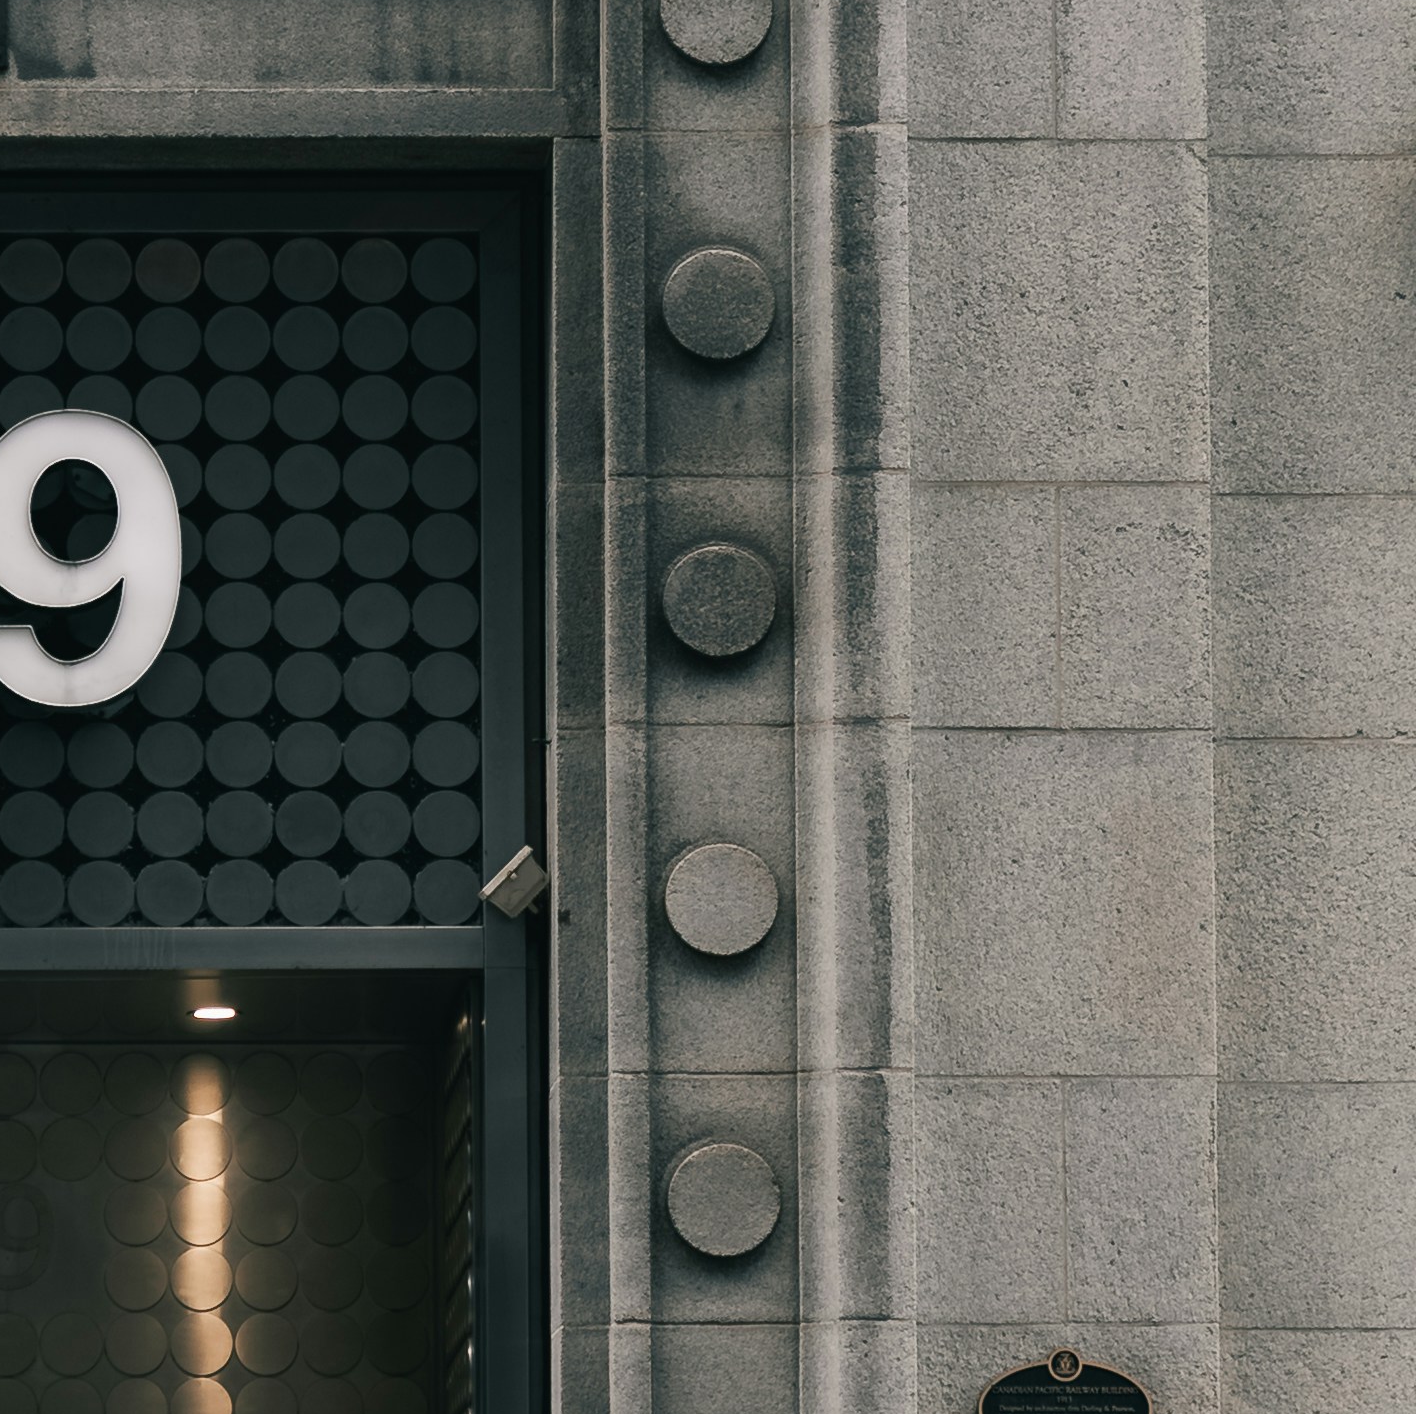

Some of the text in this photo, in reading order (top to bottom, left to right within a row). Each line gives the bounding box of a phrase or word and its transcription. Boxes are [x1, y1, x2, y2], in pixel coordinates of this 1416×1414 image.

[993, 1386, 1138, 1395] CANADIAN PACIFIC RAILWAY BUILDING
